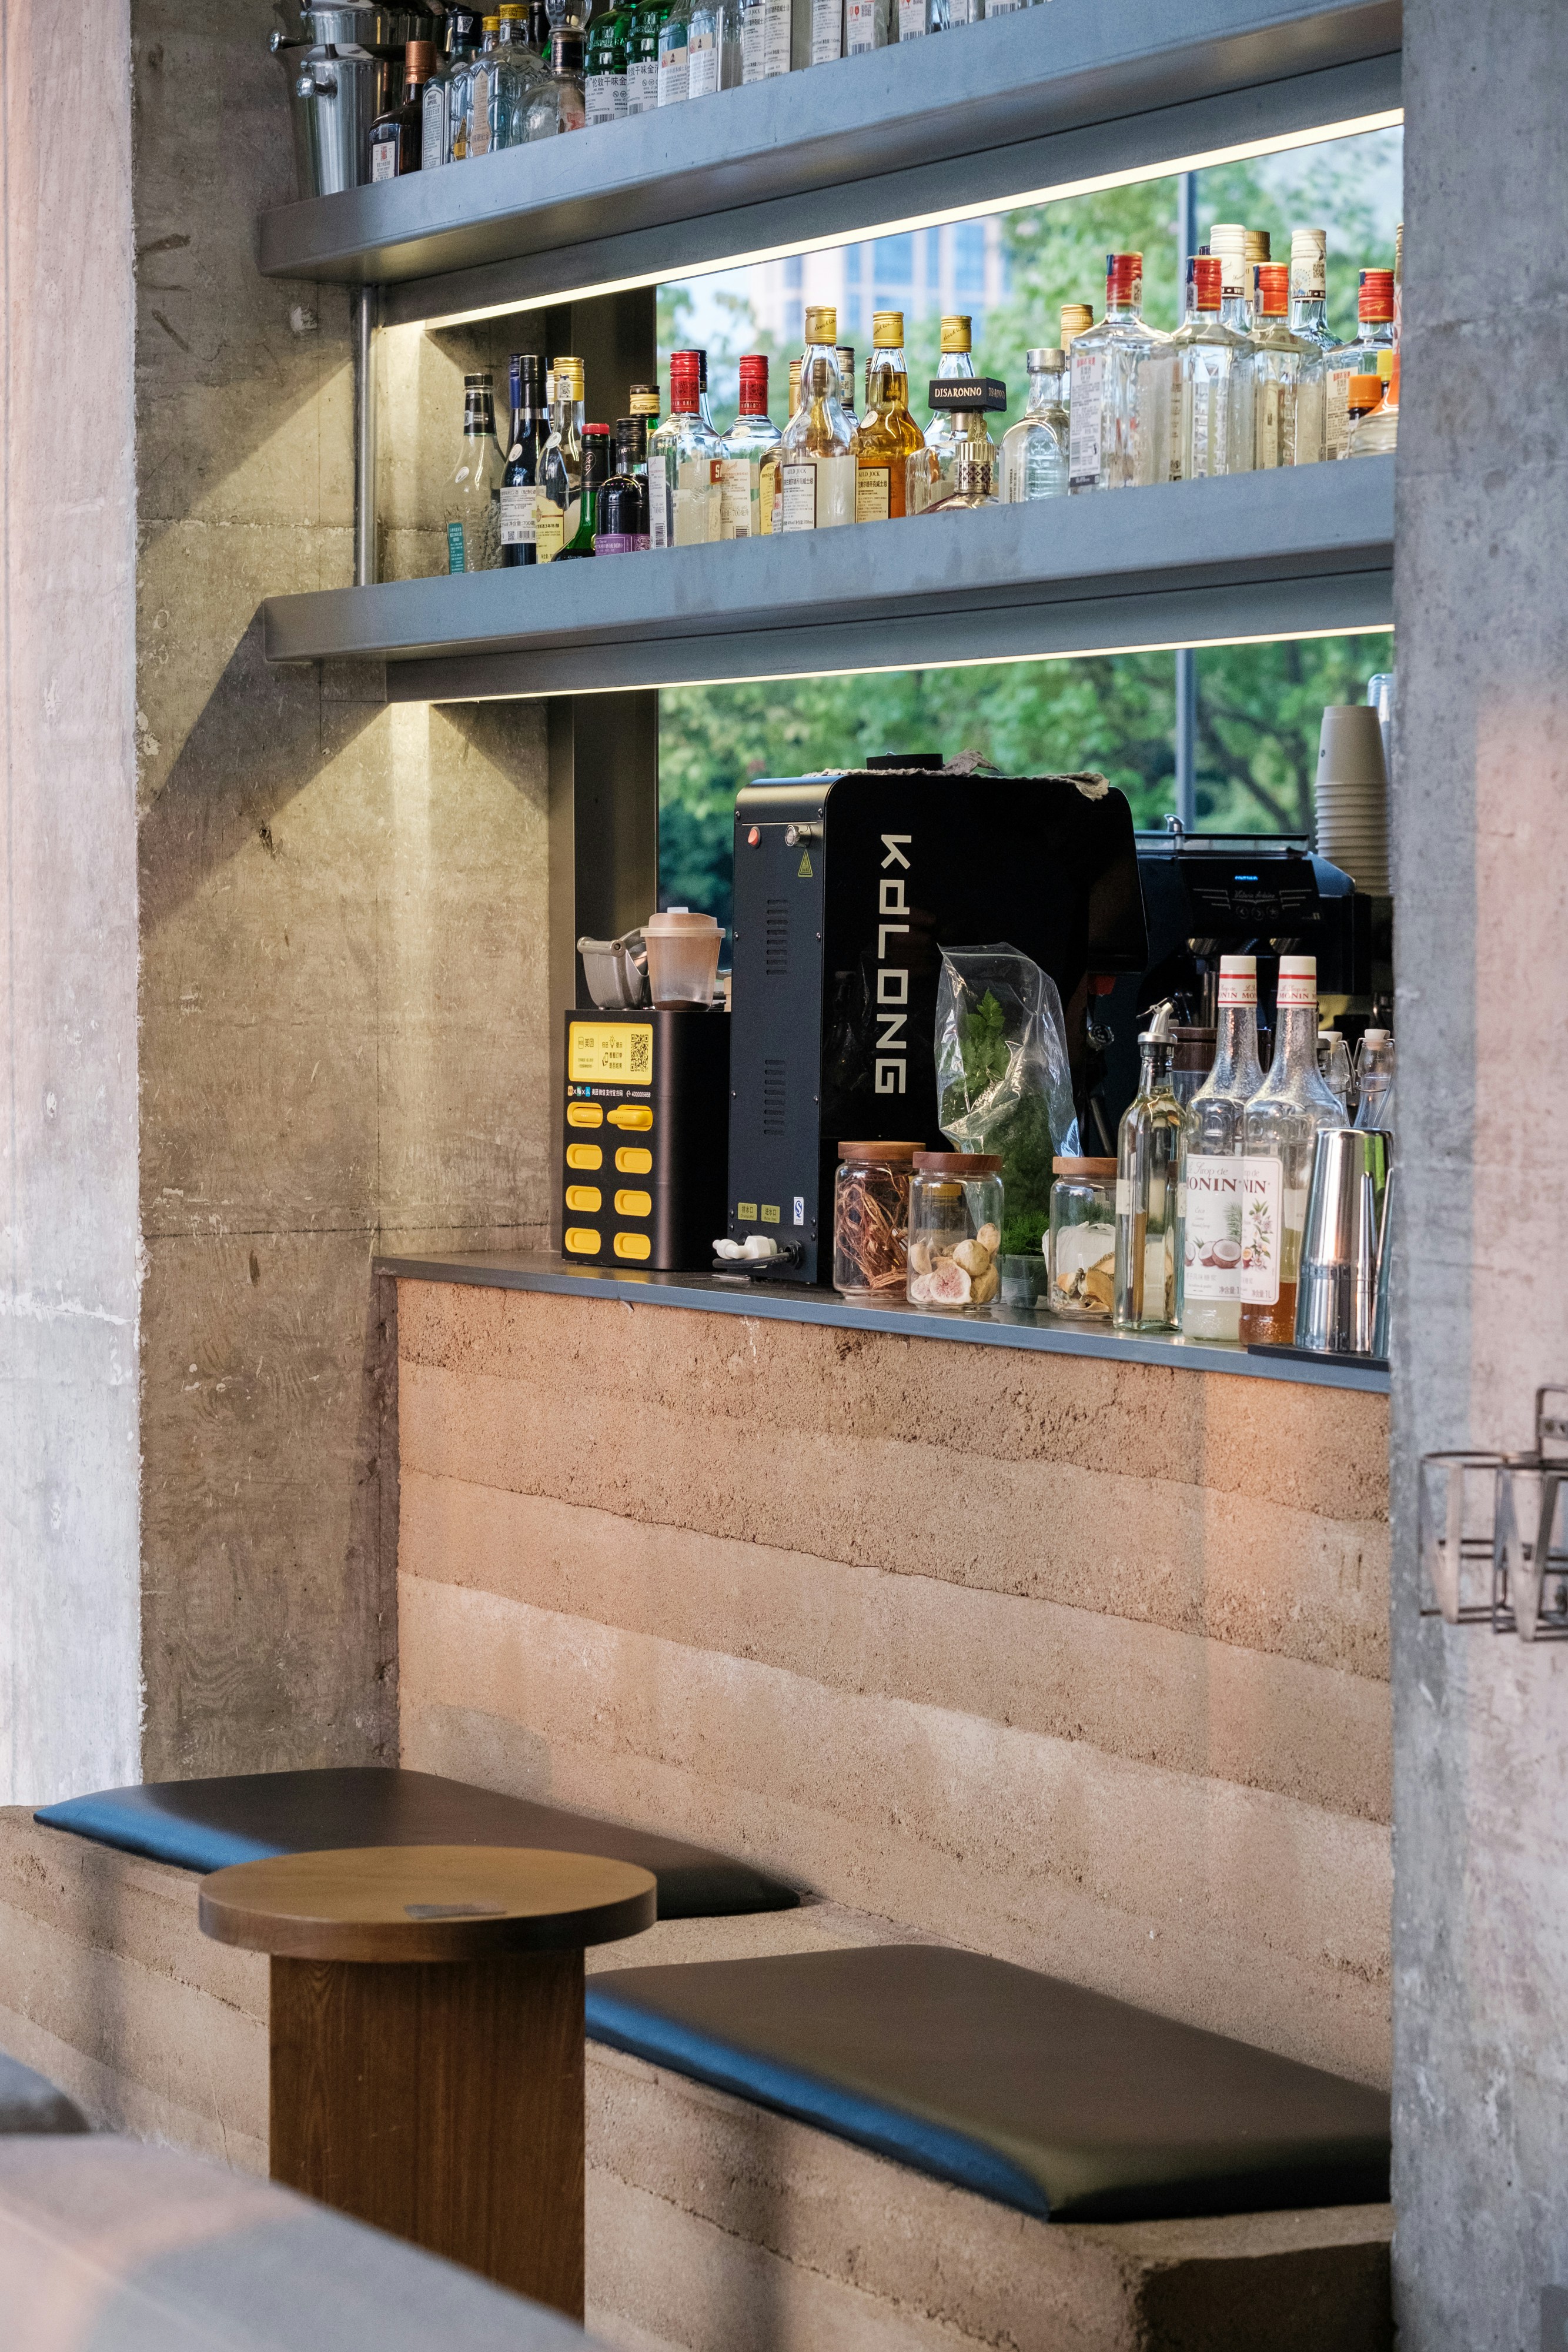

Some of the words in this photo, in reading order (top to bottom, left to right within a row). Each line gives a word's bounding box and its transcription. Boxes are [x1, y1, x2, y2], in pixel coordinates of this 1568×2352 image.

[935, 387, 982, 397] DISARONNO
[989, 387, 1005, 400] DISARONNO
[584, 1038, 594, 1048] 美团
[1194, 1161, 1215, 1177] Sirop
[1244, 1179, 1267, 1194] NIN
[742, 1205, 753, 1214] 排水口
[765, 1208, 776, 1216] 进水口
[1219, 1286, 1235, 1294] 净含量
[1252, 1289, 1263, 1298] 净含量
[1264, 1290, 1271, 1298] 1L
